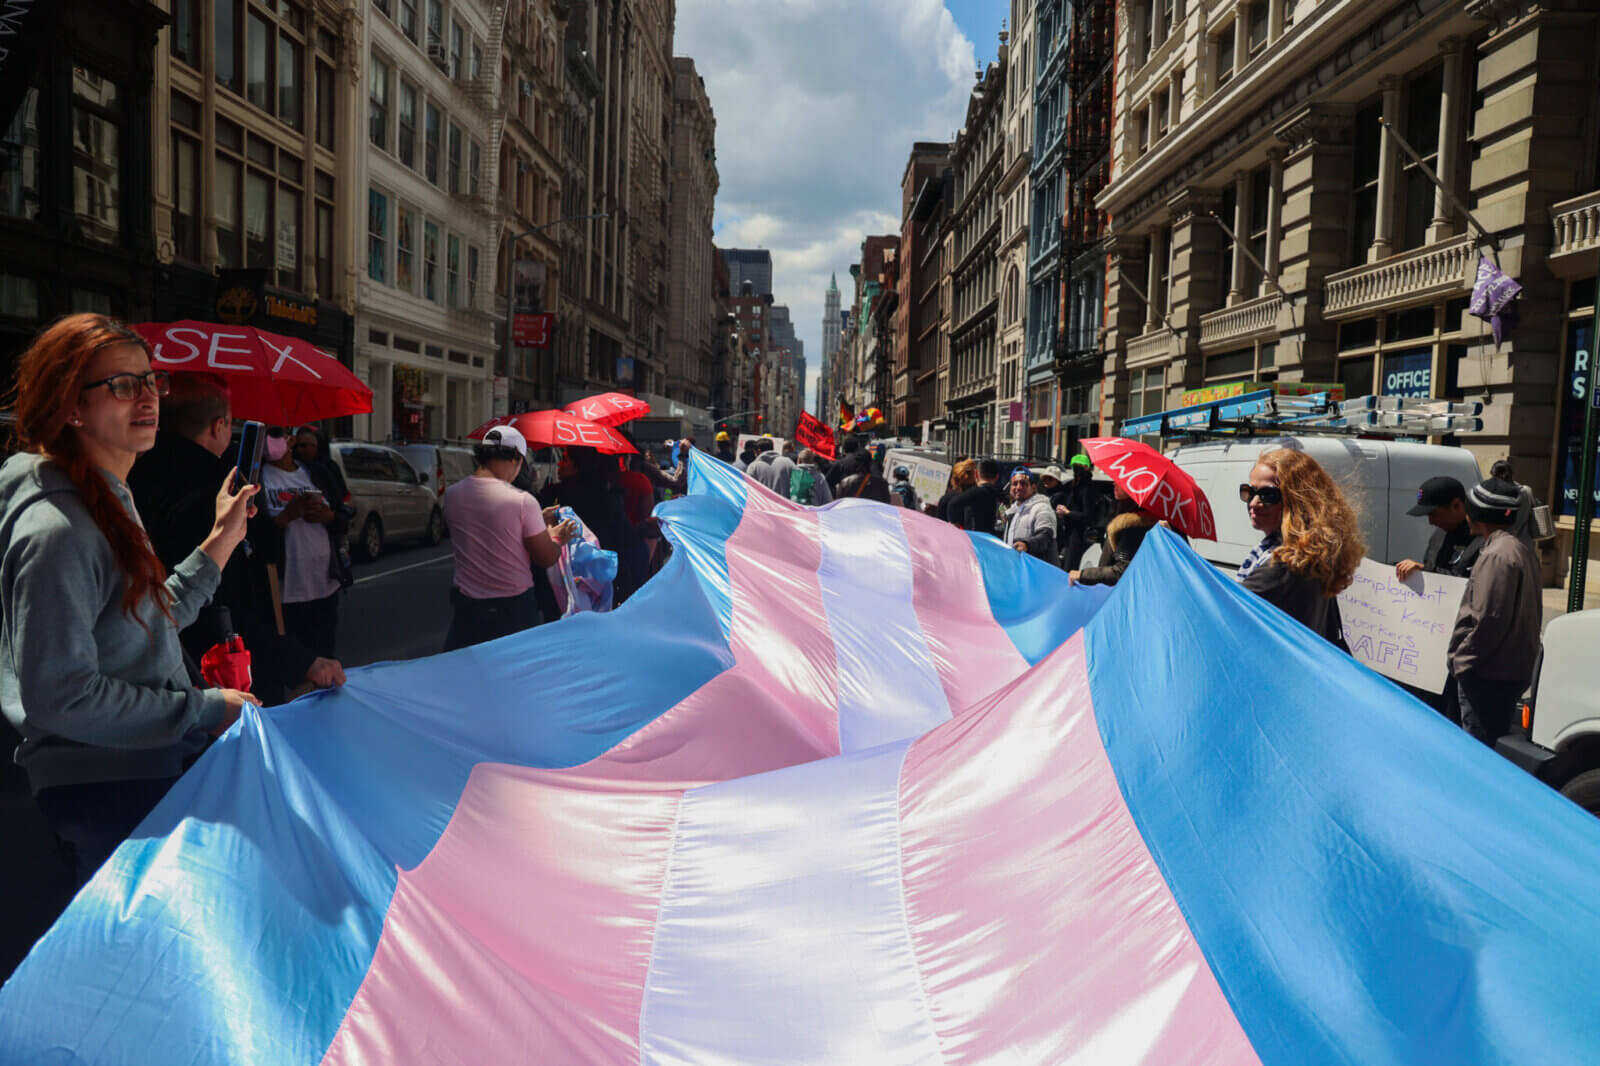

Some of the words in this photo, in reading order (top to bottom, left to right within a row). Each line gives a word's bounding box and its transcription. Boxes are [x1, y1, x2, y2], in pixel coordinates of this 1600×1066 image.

[154, 327, 322, 380] SEX
[1386, 369, 1431, 390] OFFICE
[1108, 451, 1193, 530] WORK
[1197, 500, 1212, 537] IS
